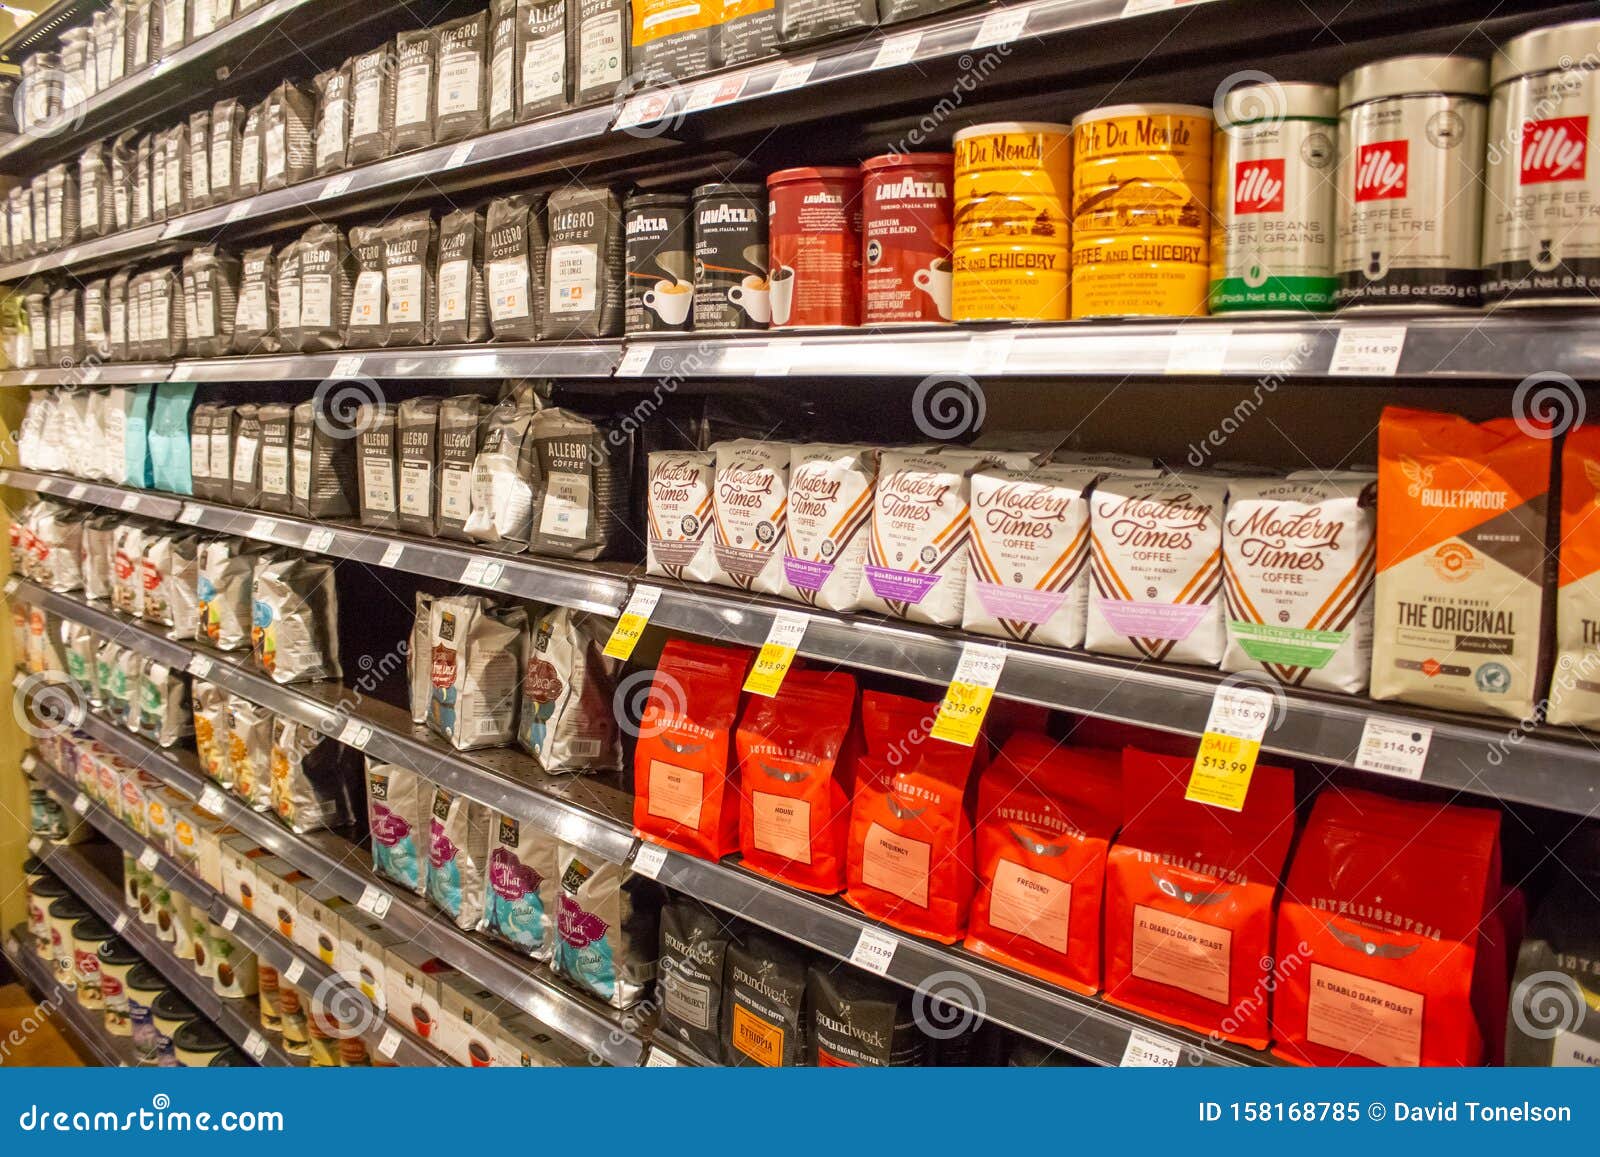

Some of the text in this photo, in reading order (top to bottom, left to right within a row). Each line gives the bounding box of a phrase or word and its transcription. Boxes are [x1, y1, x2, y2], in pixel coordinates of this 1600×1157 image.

[1106, 118, 1190, 147] Du Monde
[969, 140, 986, 163] Du
[1523, 127, 1584, 177] illy
[1357, 150, 1405, 195] illy
[876, 177, 947, 201] LAVAZZA
[1237, 168, 1281, 208] illy
[803, 192, 842, 204] LAVAZZA
[553, 211, 594, 232] ALLEGRO
[700, 204, 757, 225] LAVAZZA
[868, 218, 899, 229] PREMIUM
[555, 230, 589, 241] COFFEE
[889, 225, 917, 235] BLEND
[1264, 221, 1320, 232] BEANS
[491, 226, 522, 249] ALLEGRO
[1239, 233, 1325, 244] EN GRAINS
[493, 243, 519, 257] COFFEE
[1106, 244, 1201, 263] AND CHICORY
[968, 253, 1057, 270] AND CHICORY
[1389, 285, 1411, 295] 8.8
[1412, 287, 1427, 295] oz
[363, 433, 389, 446] ALLEGRO
[402, 432, 428, 446] ALLEGRO
[444, 433, 470, 448] ALLEGRO
[548, 442, 587, 459] ALLEGRO
[553, 460, 584, 469] COFFEE
[651, 460, 700, 484] Modern
[719, 462, 775, 488] Modern
[790, 467, 841, 496] Modern
[880, 469, 950, 500] Modern
[653, 482, 690, 502] Times
[720, 484, 762, 508] Times
[977, 483, 1071, 516] Modern
[1258, 486, 1298, 497] WHOLE
[1421, 489, 1508, 510] BULLETPROOF
[729, 509, 750, 518] COFFEE
[792, 492, 827, 518] Times
[882, 494, 930, 522] Times
[1099, 494, 1212, 522] Modern
[798, 518, 816, 527] COFFEE
[891, 522, 916, 531] COFFEE
[986, 509, 1053, 540] Times
[1228, 505, 1344, 546] Modern
[1002, 538, 1035, 550] COFFEE
[1111, 520, 1193, 550] Times
[1477, 534, 1520, 542] ENERGIZE
[1132, 551, 1172, 562] COFFEE
[1240, 538, 1324, 571] Times
[874, 572, 923, 586] GUARDIAN SPIRIT
[1262, 572, 1303, 584] COFFEE
[1397, 601, 1516, 636] THE ORIGINAL
[758, 660, 786, 672] $13.99
[945, 702, 982, 716] $13.99
[1205, 738, 1234, 753] SALE
[1383, 742, 1424, 756] $14.99
[1202, 756, 1247, 774] $13.99
[775, 807, 794, 816] HOUSE
[997, 807, 1085, 842] INTELLIGENTSIA
[880, 839, 909, 856] FREQUENCY
[1137, 850, 1247, 887] INTELLIGENTSIA
[1017, 877, 1050, 895] FREQUENCY
[1311, 897, 1441, 942] INTELLIGENTSIA
[1149, 922, 1176, 938] DIABLO
[1177, 931, 1197, 945] DARK
[1199, 937, 1223, 951] ROAST
[868, 944, 892, 959] $13.99
[733, 965, 792, 1007] groundwork
[1316, 979, 1414, 1017] EL DIABLO DARK ROAST
[768, 1010, 785, 1023] COFFEE
[739, 1023, 773, 1053] ETHIOPIA
[815, 1009, 886, 1048] groundwork
[837, 1043, 859, 1060] ORGANIC
[859, 1051, 880, 1066] COFFEE
[1143, 1051, 1174, 1067] $13.99
